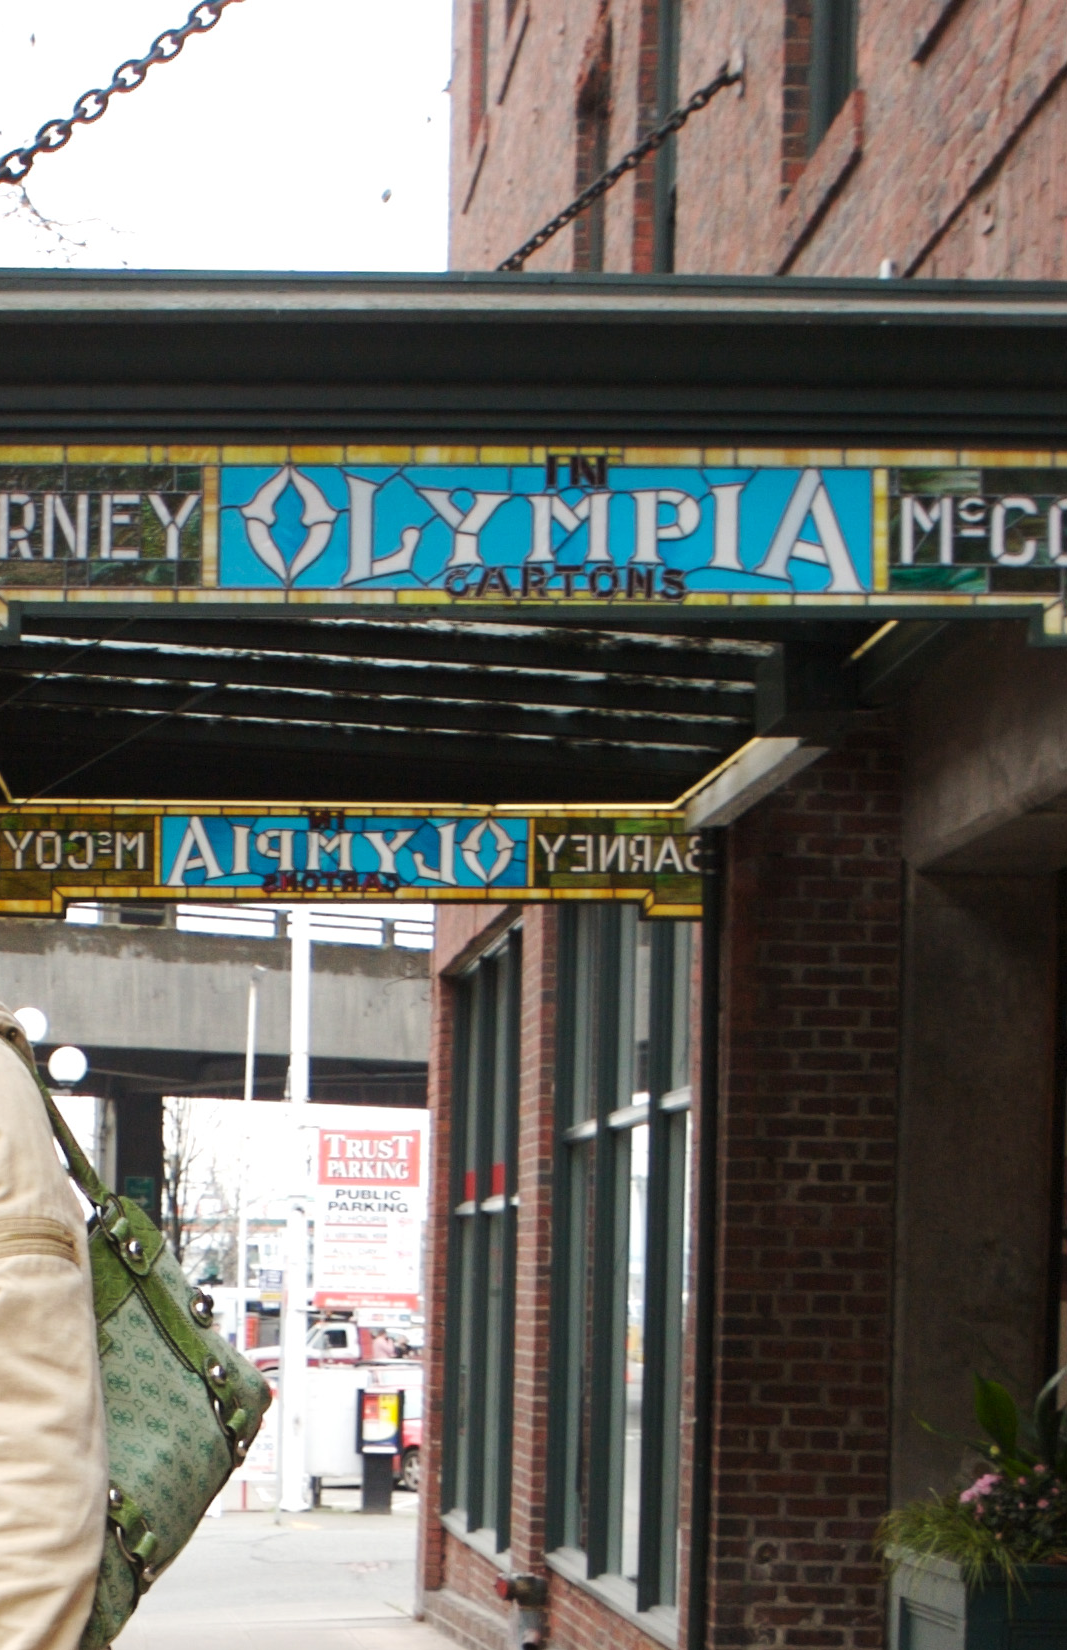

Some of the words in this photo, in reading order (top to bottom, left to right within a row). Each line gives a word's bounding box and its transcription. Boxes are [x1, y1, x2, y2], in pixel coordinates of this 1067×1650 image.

[546, 455, 609, 489] IN
[240, 463, 867, 593] OLYMPIA
[900, 495, 1067, 567] McC
[444, 565, 688, 600] CARTONS
[323, 1134, 413, 1160] TRUST
[326, 1160, 409, 1180] PARKING
[328, 1201, 409, 1213] PARKING
[335, 1188, 402, 1201] PUBLIC
